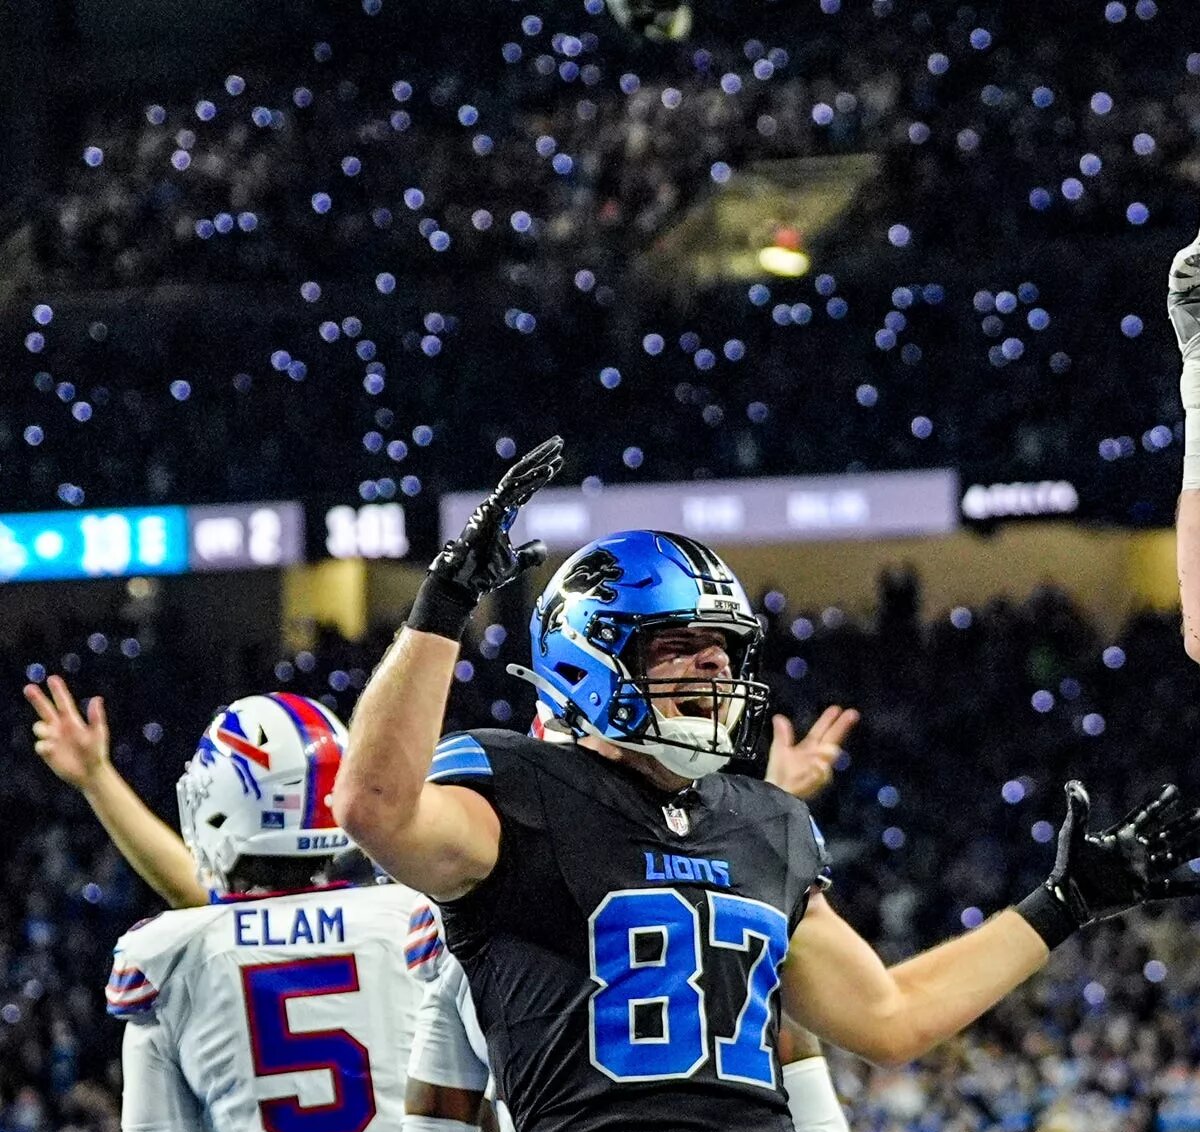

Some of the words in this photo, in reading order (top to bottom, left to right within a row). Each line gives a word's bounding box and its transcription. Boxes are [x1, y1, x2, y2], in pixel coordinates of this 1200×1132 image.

[297, 832, 350, 850] BILLS
[644, 852, 731, 887] LIONS
[233, 907, 345, 946] ELAM
[588, 887, 790, 1091] 87
